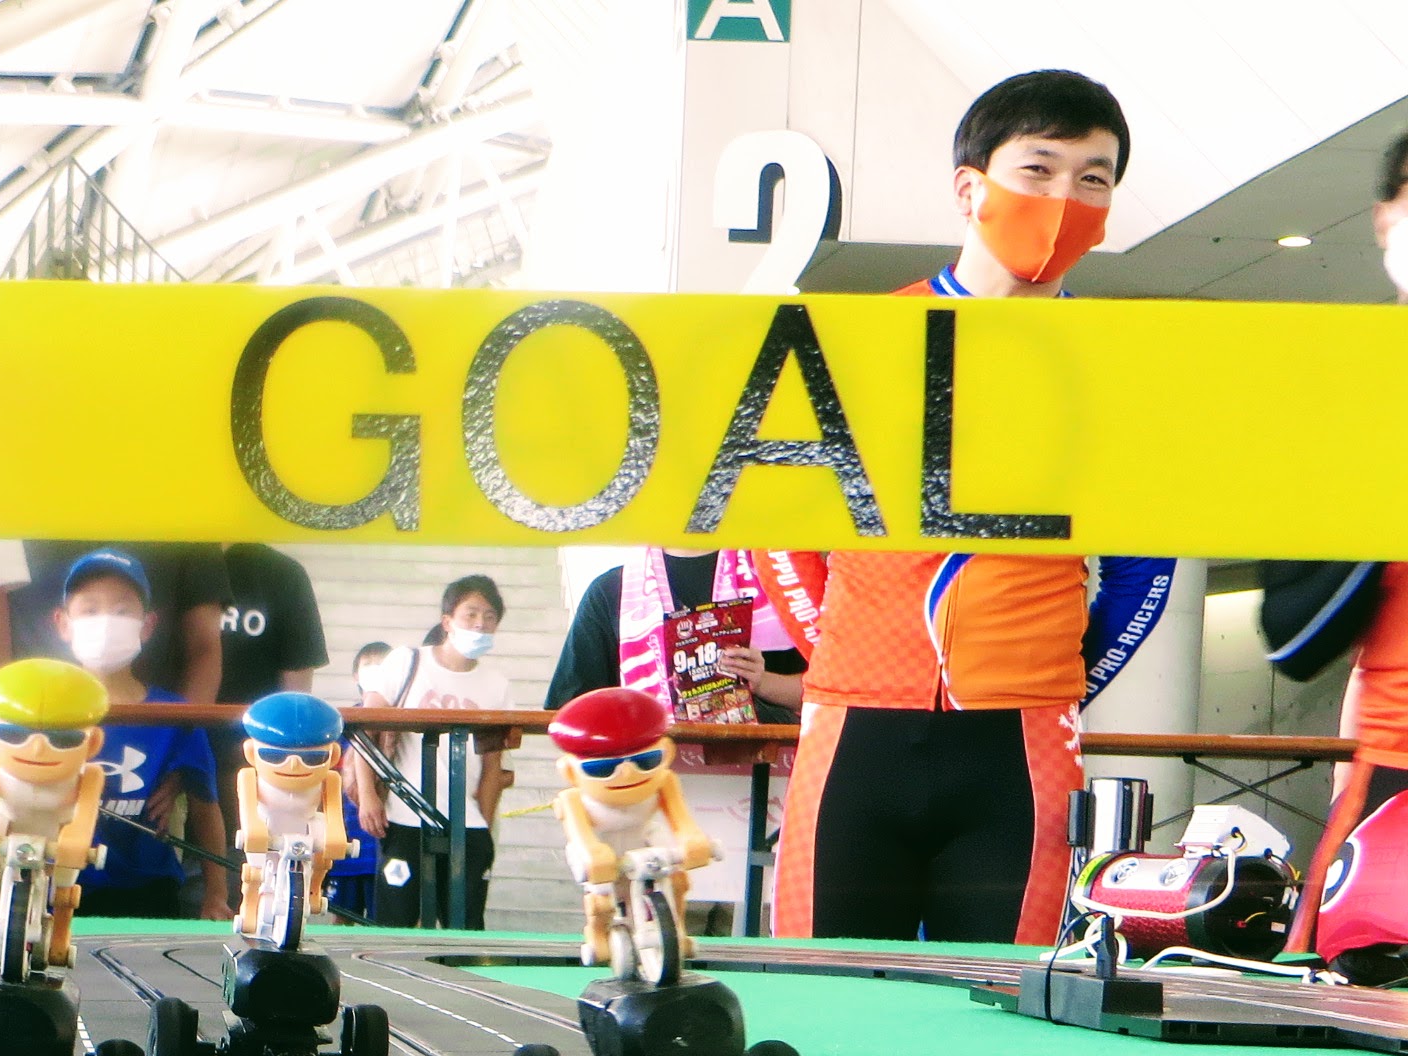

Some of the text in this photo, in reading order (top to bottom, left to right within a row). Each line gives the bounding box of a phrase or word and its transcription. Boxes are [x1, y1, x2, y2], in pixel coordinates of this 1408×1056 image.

[230, 295, 1072, 541] GOAL
[767, 549, 800, 586] PPU
[1089, 575, 1170, 681] PRO-RACERS
